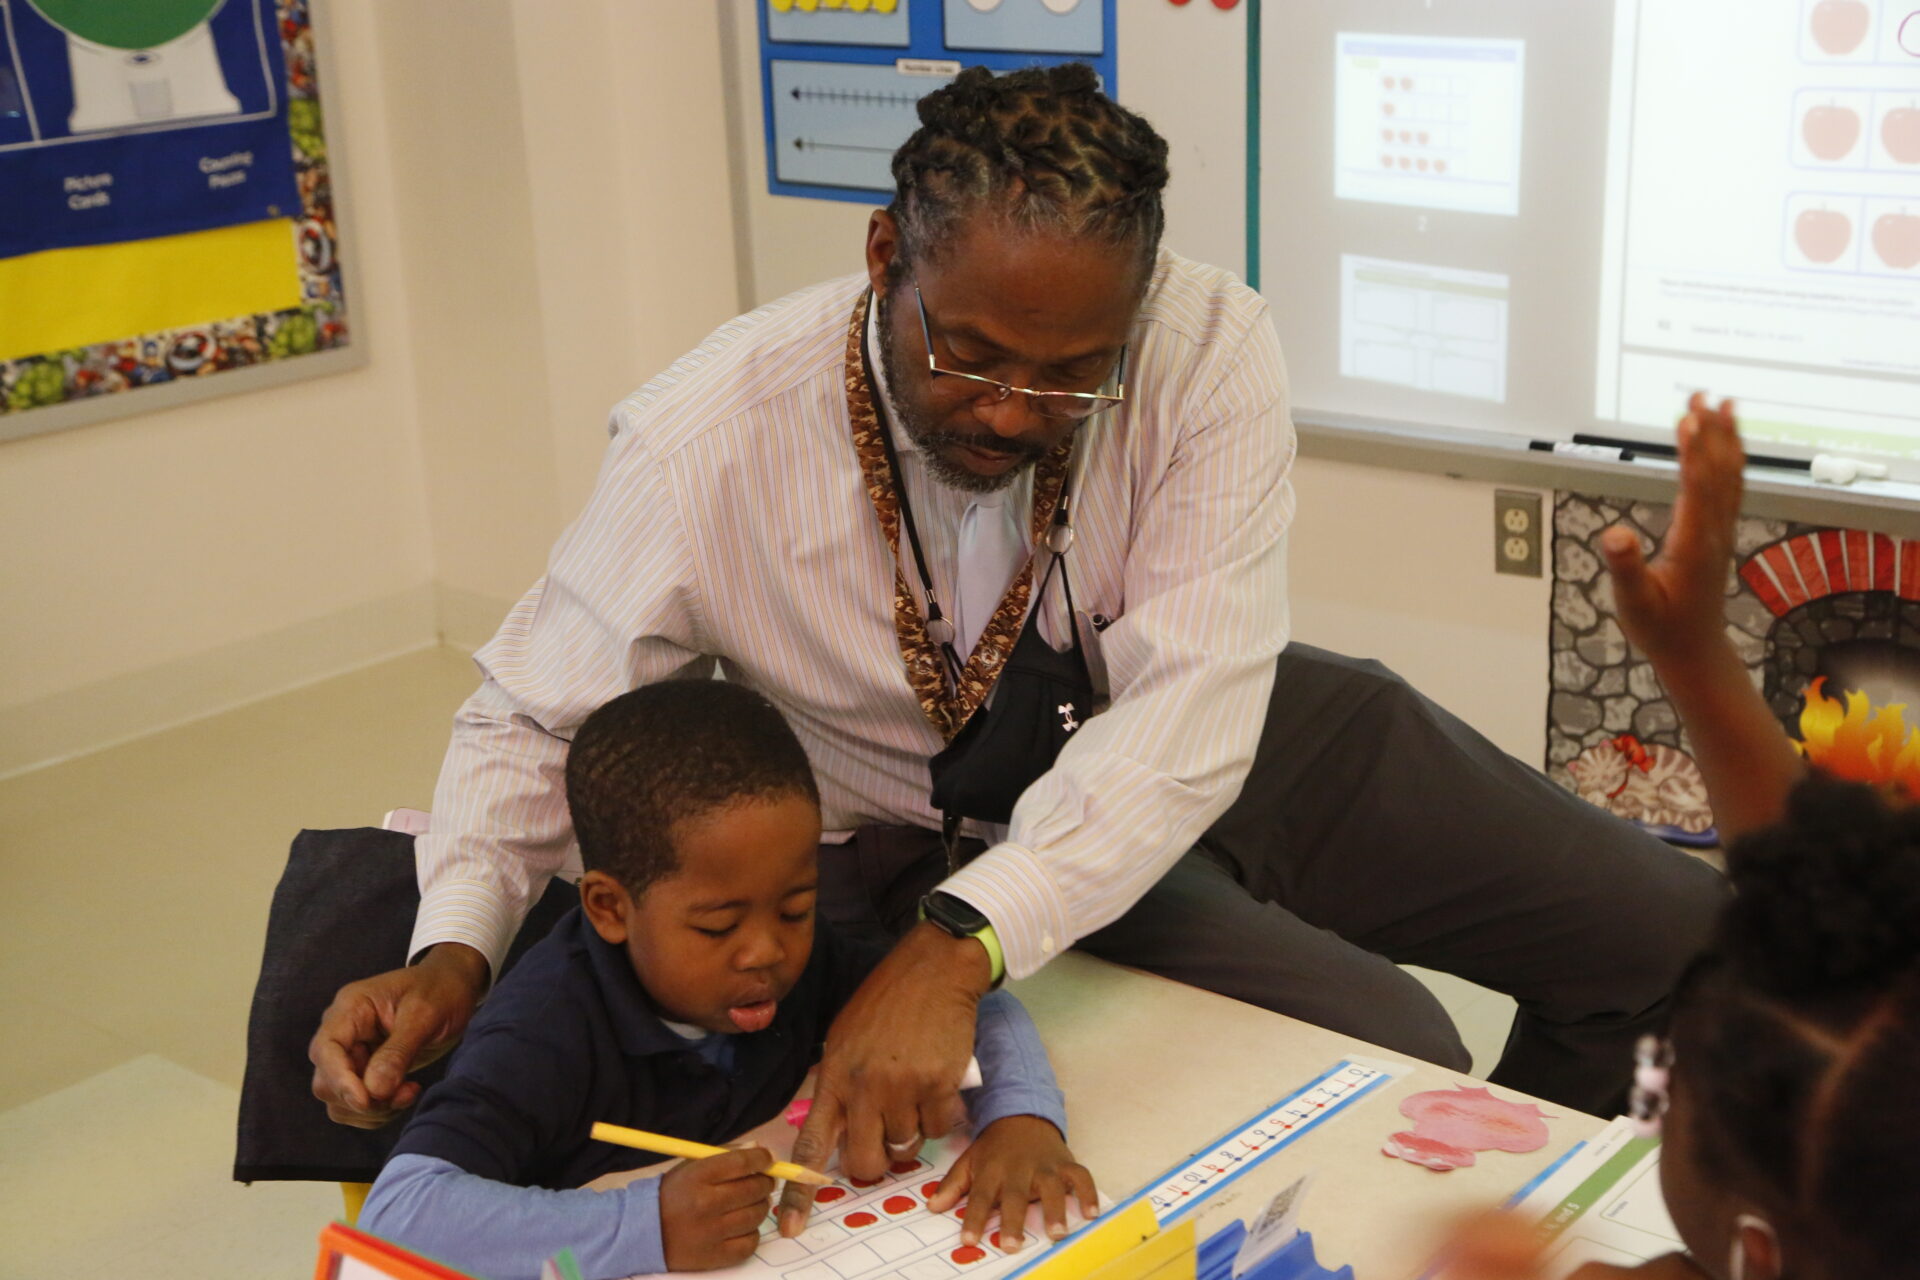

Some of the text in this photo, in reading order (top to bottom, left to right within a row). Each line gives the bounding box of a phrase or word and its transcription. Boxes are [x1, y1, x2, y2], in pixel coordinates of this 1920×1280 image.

[1316, 1087, 1332, 1095] 2
[1253, 1128, 1267, 1136] 6
[1220, 1151, 1234, 1159] 8
[1183, 1172, 1203, 1182] 10
[1166, 1184, 1183, 1193] 11
